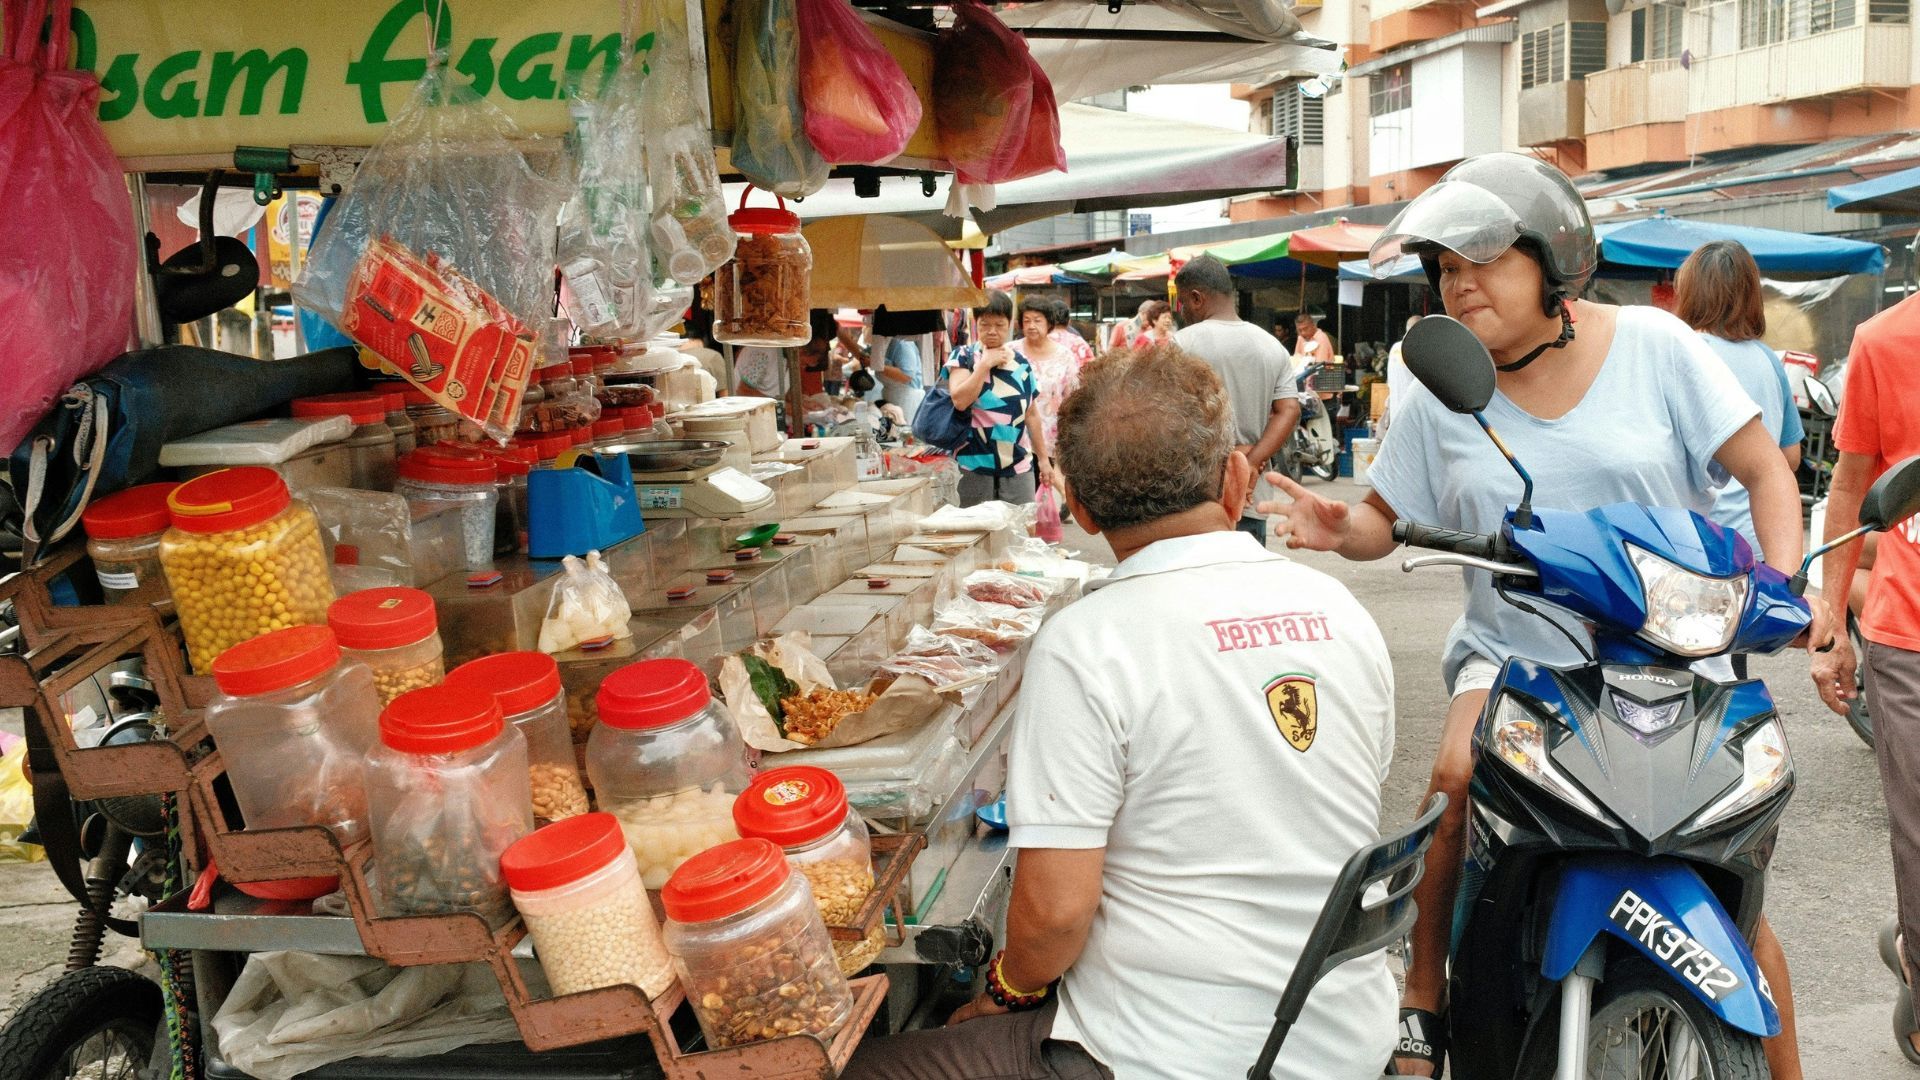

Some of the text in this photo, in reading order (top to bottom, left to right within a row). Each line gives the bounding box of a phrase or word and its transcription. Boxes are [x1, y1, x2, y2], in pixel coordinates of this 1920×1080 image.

[1205, 611, 1334, 653] Ferrari
[1618, 674, 1678, 687] HONDA
[1609, 889, 1728, 1000] PPK9732
